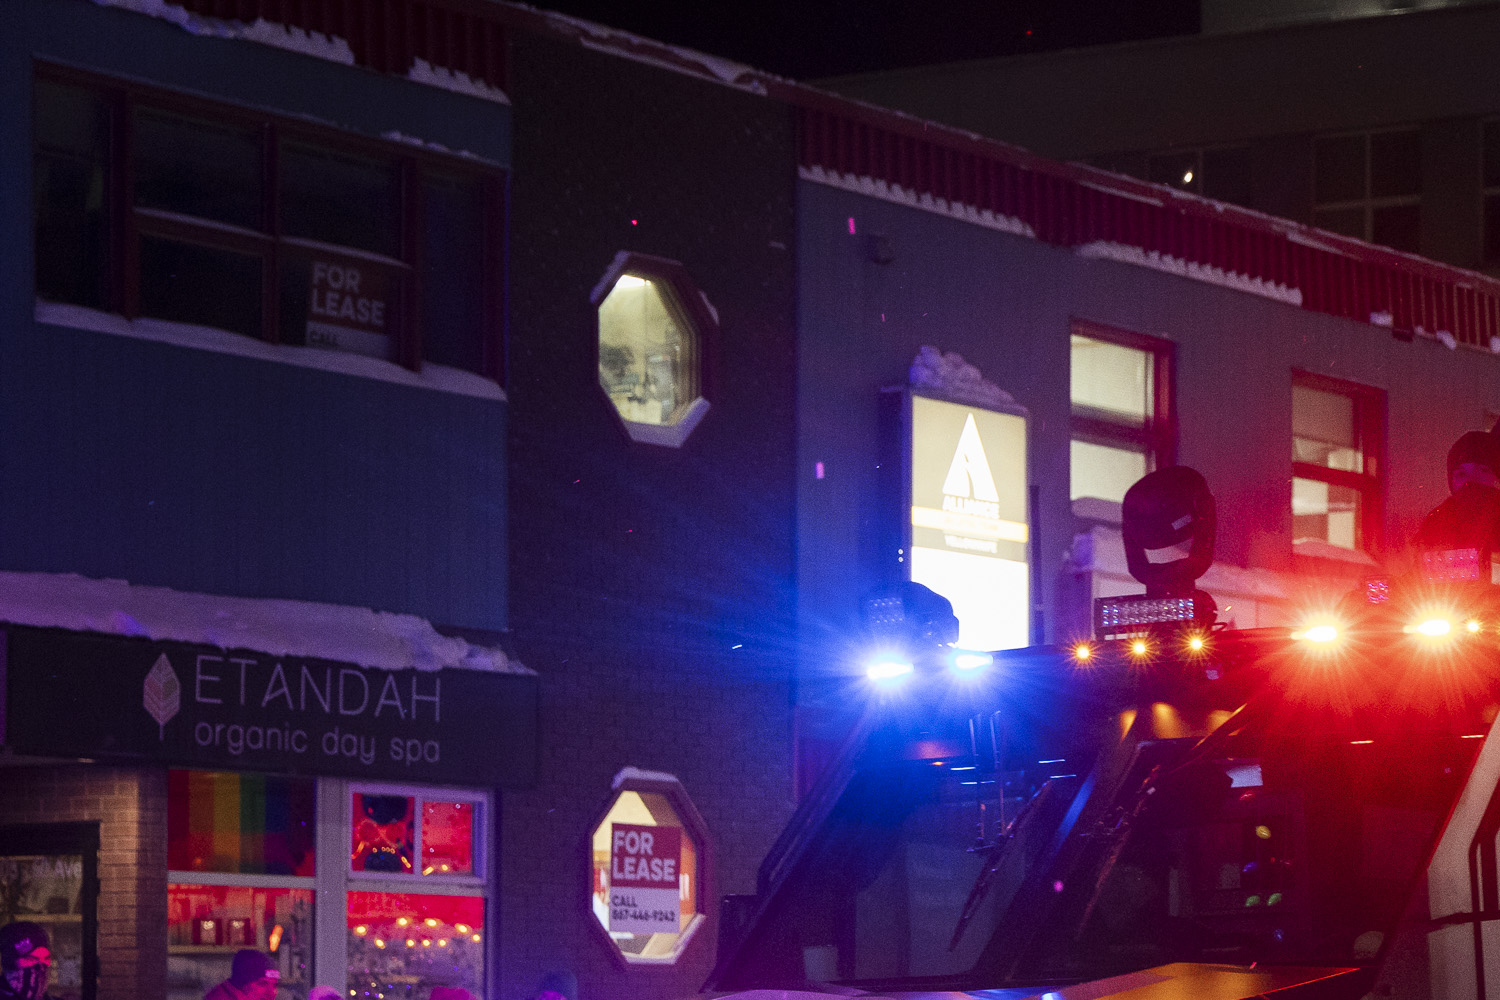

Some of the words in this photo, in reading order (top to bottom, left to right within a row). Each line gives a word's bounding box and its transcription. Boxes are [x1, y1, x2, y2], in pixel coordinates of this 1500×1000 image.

[312, 261, 360, 294] FOR
[311, 287, 385, 327] LEASE
[195, 653, 441, 723] ETANDAH
[194, 721, 308, 756] organic
[321, 726, 376, 766] day
[389, 736, 441, 767] spa
[613, 830, 654, 856] FOR
[612, 856, 676, 883] LEASE
[611, 894, 638, 908] CALL
